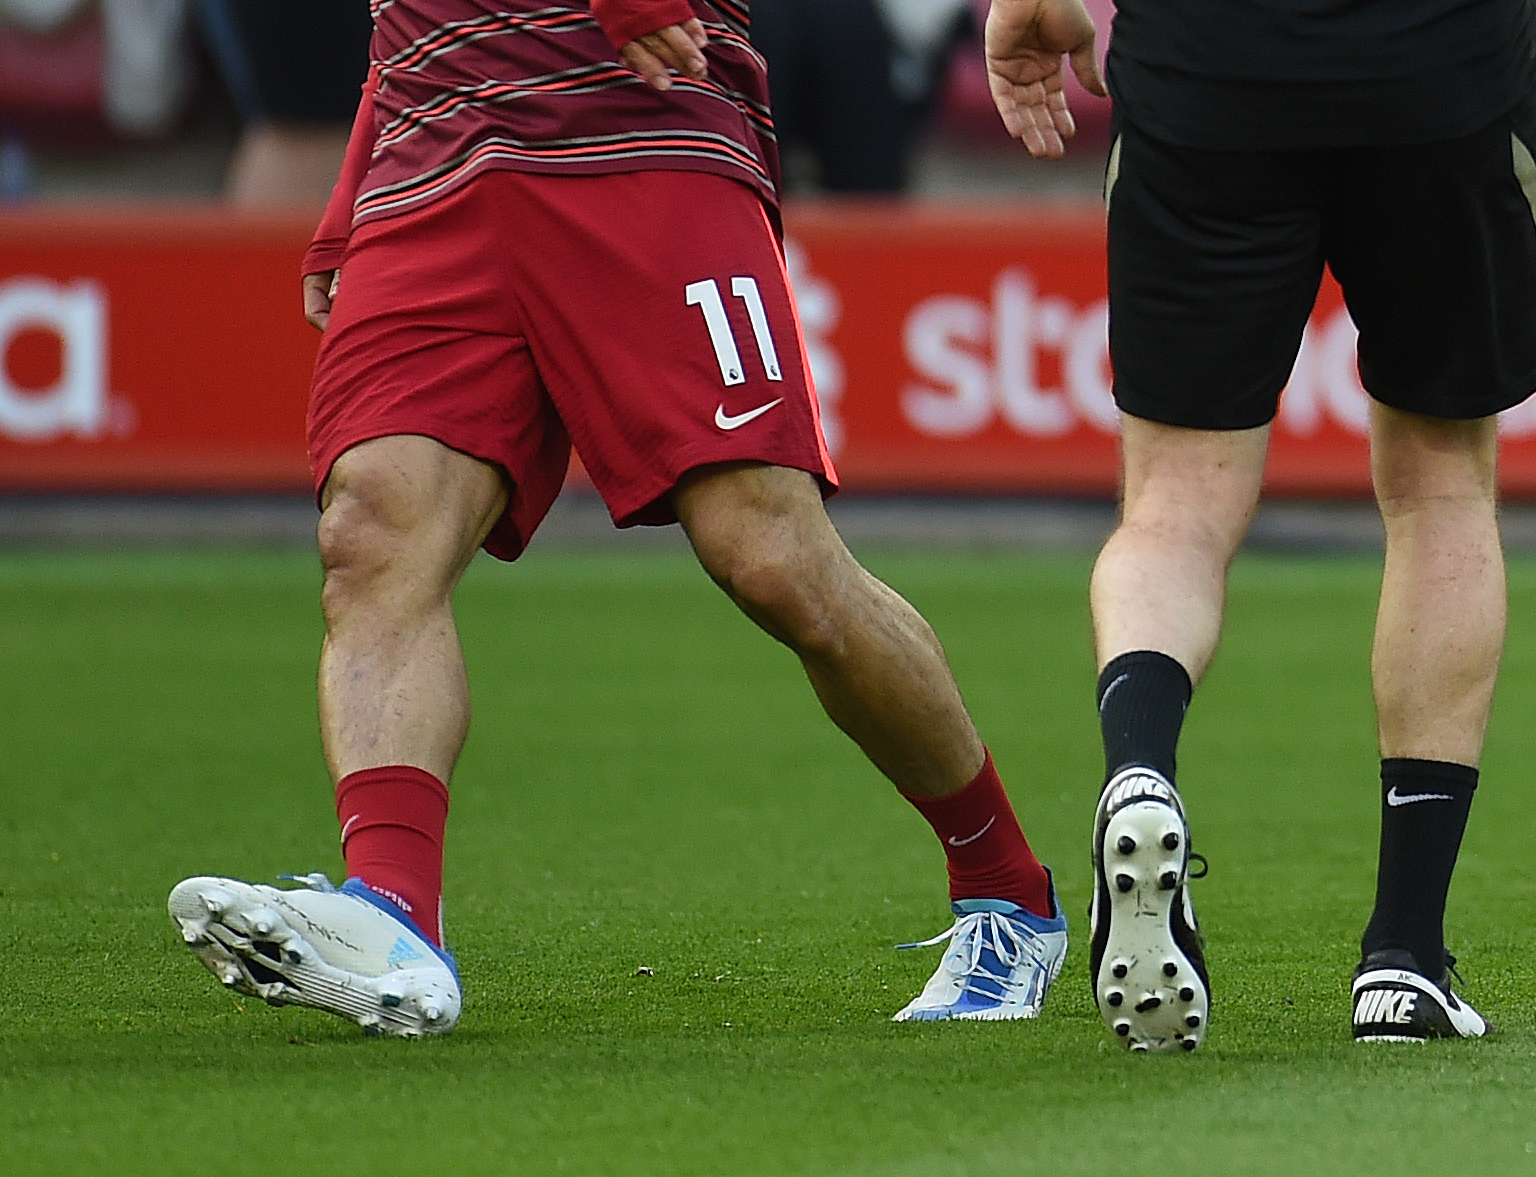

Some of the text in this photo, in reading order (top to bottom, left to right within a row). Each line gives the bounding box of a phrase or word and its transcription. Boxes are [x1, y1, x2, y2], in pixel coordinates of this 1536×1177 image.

[685, 277, 782, 386] 11
[1106, 776, 1169, 812] NIKE
[1353, 989, 1418, 1025] NIKE
